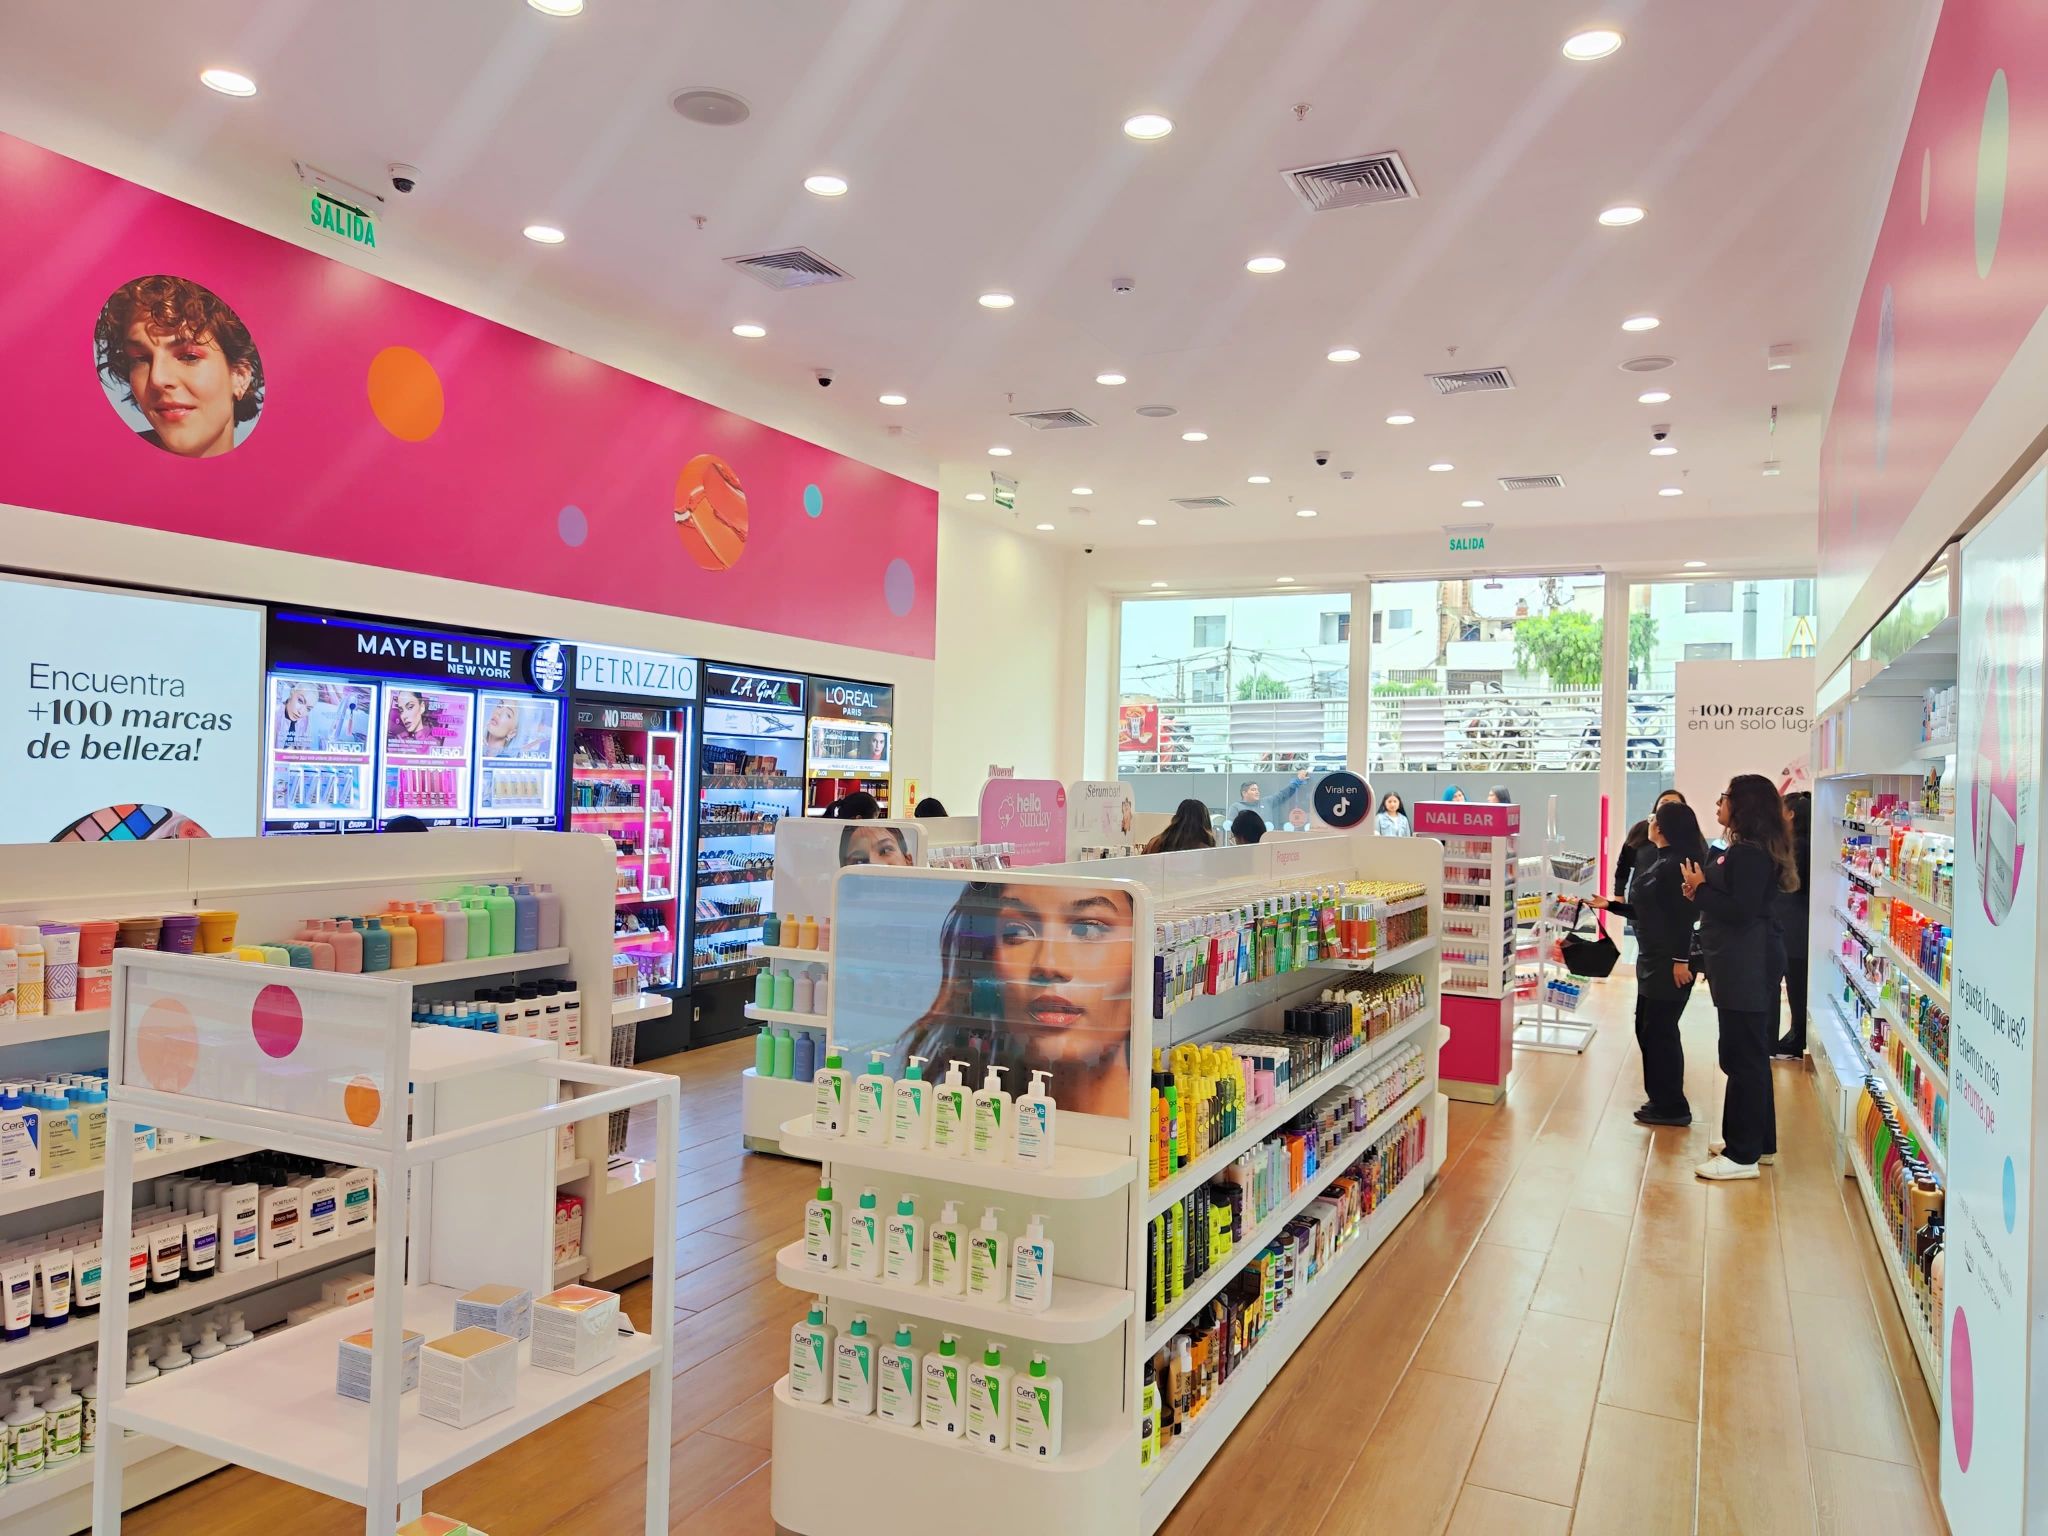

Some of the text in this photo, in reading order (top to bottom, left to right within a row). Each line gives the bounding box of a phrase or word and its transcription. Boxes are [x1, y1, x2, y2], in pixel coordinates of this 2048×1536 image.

[311, 197, 376, 249] SALIDA
[1449, 537, 1485, 551] SALIDA
[357, 633, 512, 669] MAYBELLINE
[447, 663, 512, 679] NEW YORK
[581, 655, 693, 692] PETRIZZIO
[30, 662, 185, 697] Encuentra
[730, 676, 781, 703] L.A. Girl
[825, 686, 878, 709] L'ORÉAL
[28, 698, 233, 731] +100 marcas
[842, 707, 862, 717] PARIS
[1688, 704, 1805, 717] +100 marcas
[604, 709, 619, 729] NO
[1688, 720, 1708, 731] en
[1714, 720, 1735, 730] un
[1740, 717, 1776, 730] solo
[27, 732, 202, 762] de belleza!
[1325, 785, 1345, 794] Viral
[1016, 793, 1041, 812] hello
[1019, 811, 1052, 832] sunday
[1425, 811, 1460, 825] NAIL
[1463, 813, 1493, 827] BAR
[1958, 969, 1965, 999] Te
[1965, 981, 1982, 1014] gusta
[1983, 987, 1990, 1021] lo
[1991, 1003, 2005, 1035] que
[1956, 1024, 2000, 1096] Tenemos más
[818, 1077, 840, 1087] CeraVe
[860, 1083, 881, 1094] CeraVe
[1955, 1067, 1963, 1095] en
[897, 1088, 920, 1099] CeraVe
[937, 1092, 960, 1102] CeraVe
[976, 1099, 1000, 1108] CeraVe
[1019, 1104, 1045, 1114] CeraVe
[2, 1117, 36, 1132] CeraVe
[49, 1118, 77, 1129] CeraVe
[809, 1208, 831, 1219] CeraVe
[851, 1216, 873, 1227] CeraVe
[889, 1224, 912, 1234] CeraVe
[932, 1231, 956, 1242] CeraVe
[972, 1238, 996, 1249] CeraVe
[1017, 1245, 1043, 1257] CeraVe
[794, 1333, 822, 1348] CeraVe
[838, 1344, 866, 1357] CeraVe
[882, 1355, 910, 1369] CeraVe
[926, 1364, 955, 1379] CeraVe
[970, 1373, 997, 1390] CeraVe
[1016, 1386, 1047, 1401] CeraVe
